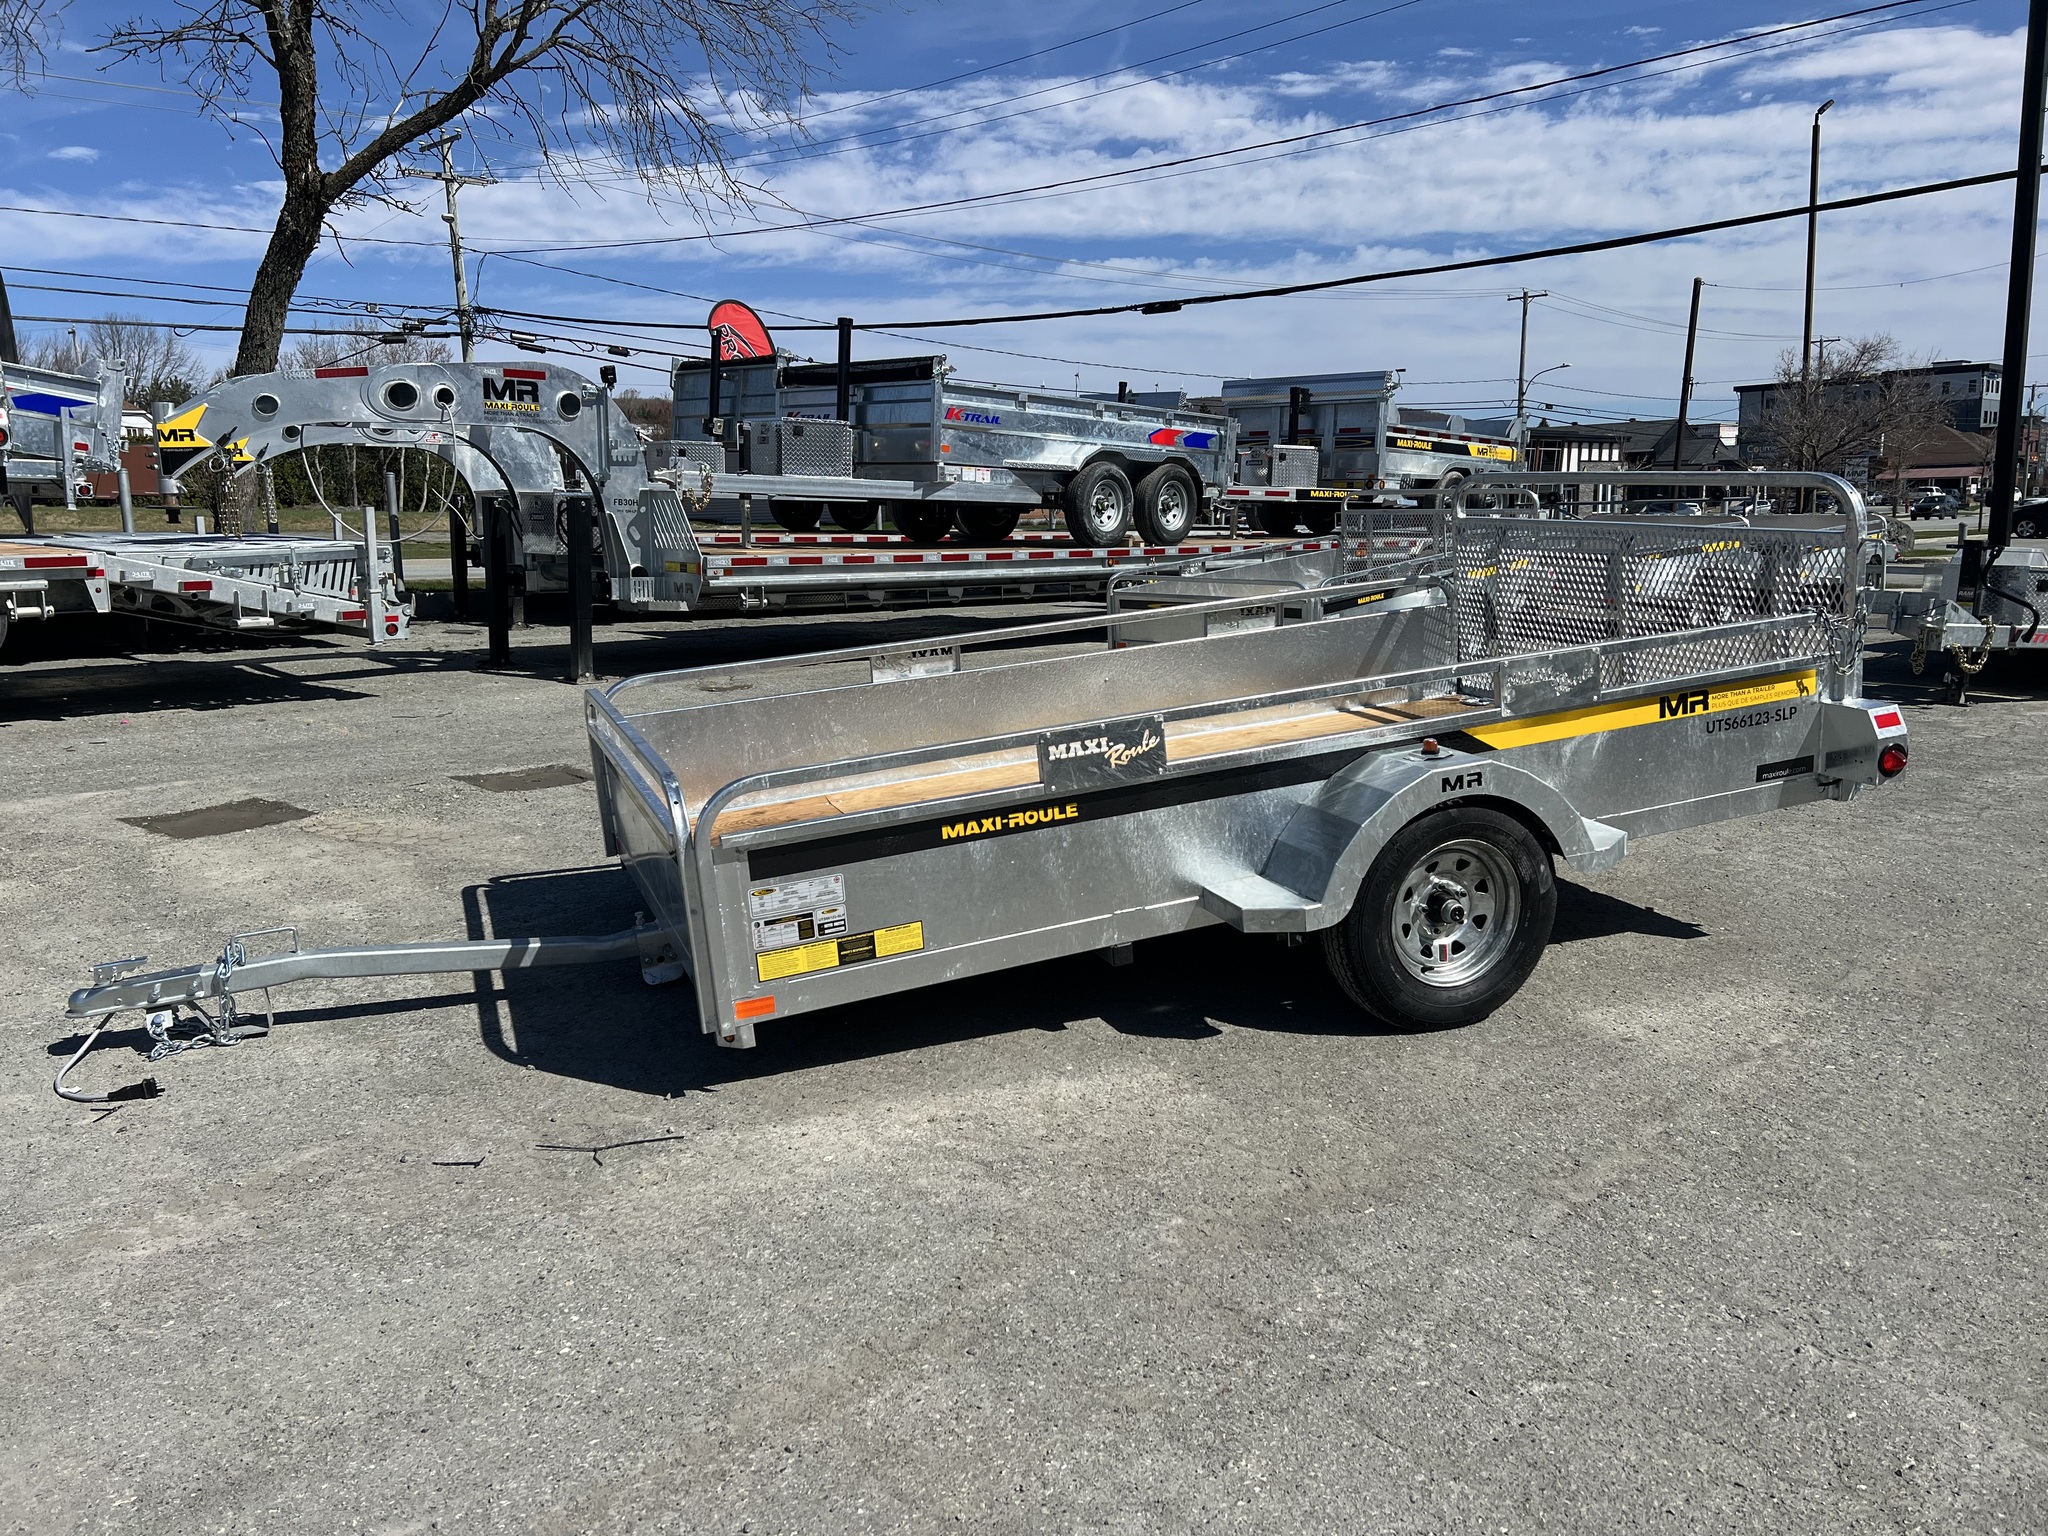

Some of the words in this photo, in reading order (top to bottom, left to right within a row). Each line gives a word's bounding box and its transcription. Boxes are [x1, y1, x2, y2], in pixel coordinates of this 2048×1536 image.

[482, 377, 539, 402] MR
[484, 402, 540, 412] MAXI-ROULE
[944, 405, 1002, 425] K-TRAIL
[157, 429, 195, 442] MR
[1397, 438, 1432, 450] MAXI-ROULE
[613, 498, 639, 506] FB30H
[673, 581, 694, 594] MR
[1711, 692, 1729, 701] MORE
[1730, 690, 1746, 698] THAN
[1753, 685, 1776, 694] TRAILER
[1711, 701, 1727, 709] PLUS
[1727, 699, 1740, 707] QUE
[1750, 693, 1773, 703] SIMPLES
[1659, 689, 1710, 719] MR
[1706, 706, 1798, 734] UTS66123-SLP
[1048, 736, 1114, 761] MAXI-
[1104, 729, 1160, 769] Roule
[1441, 771, 1483, 793] MR
[941, 802, 1079, 840] MAXI-ROULE
